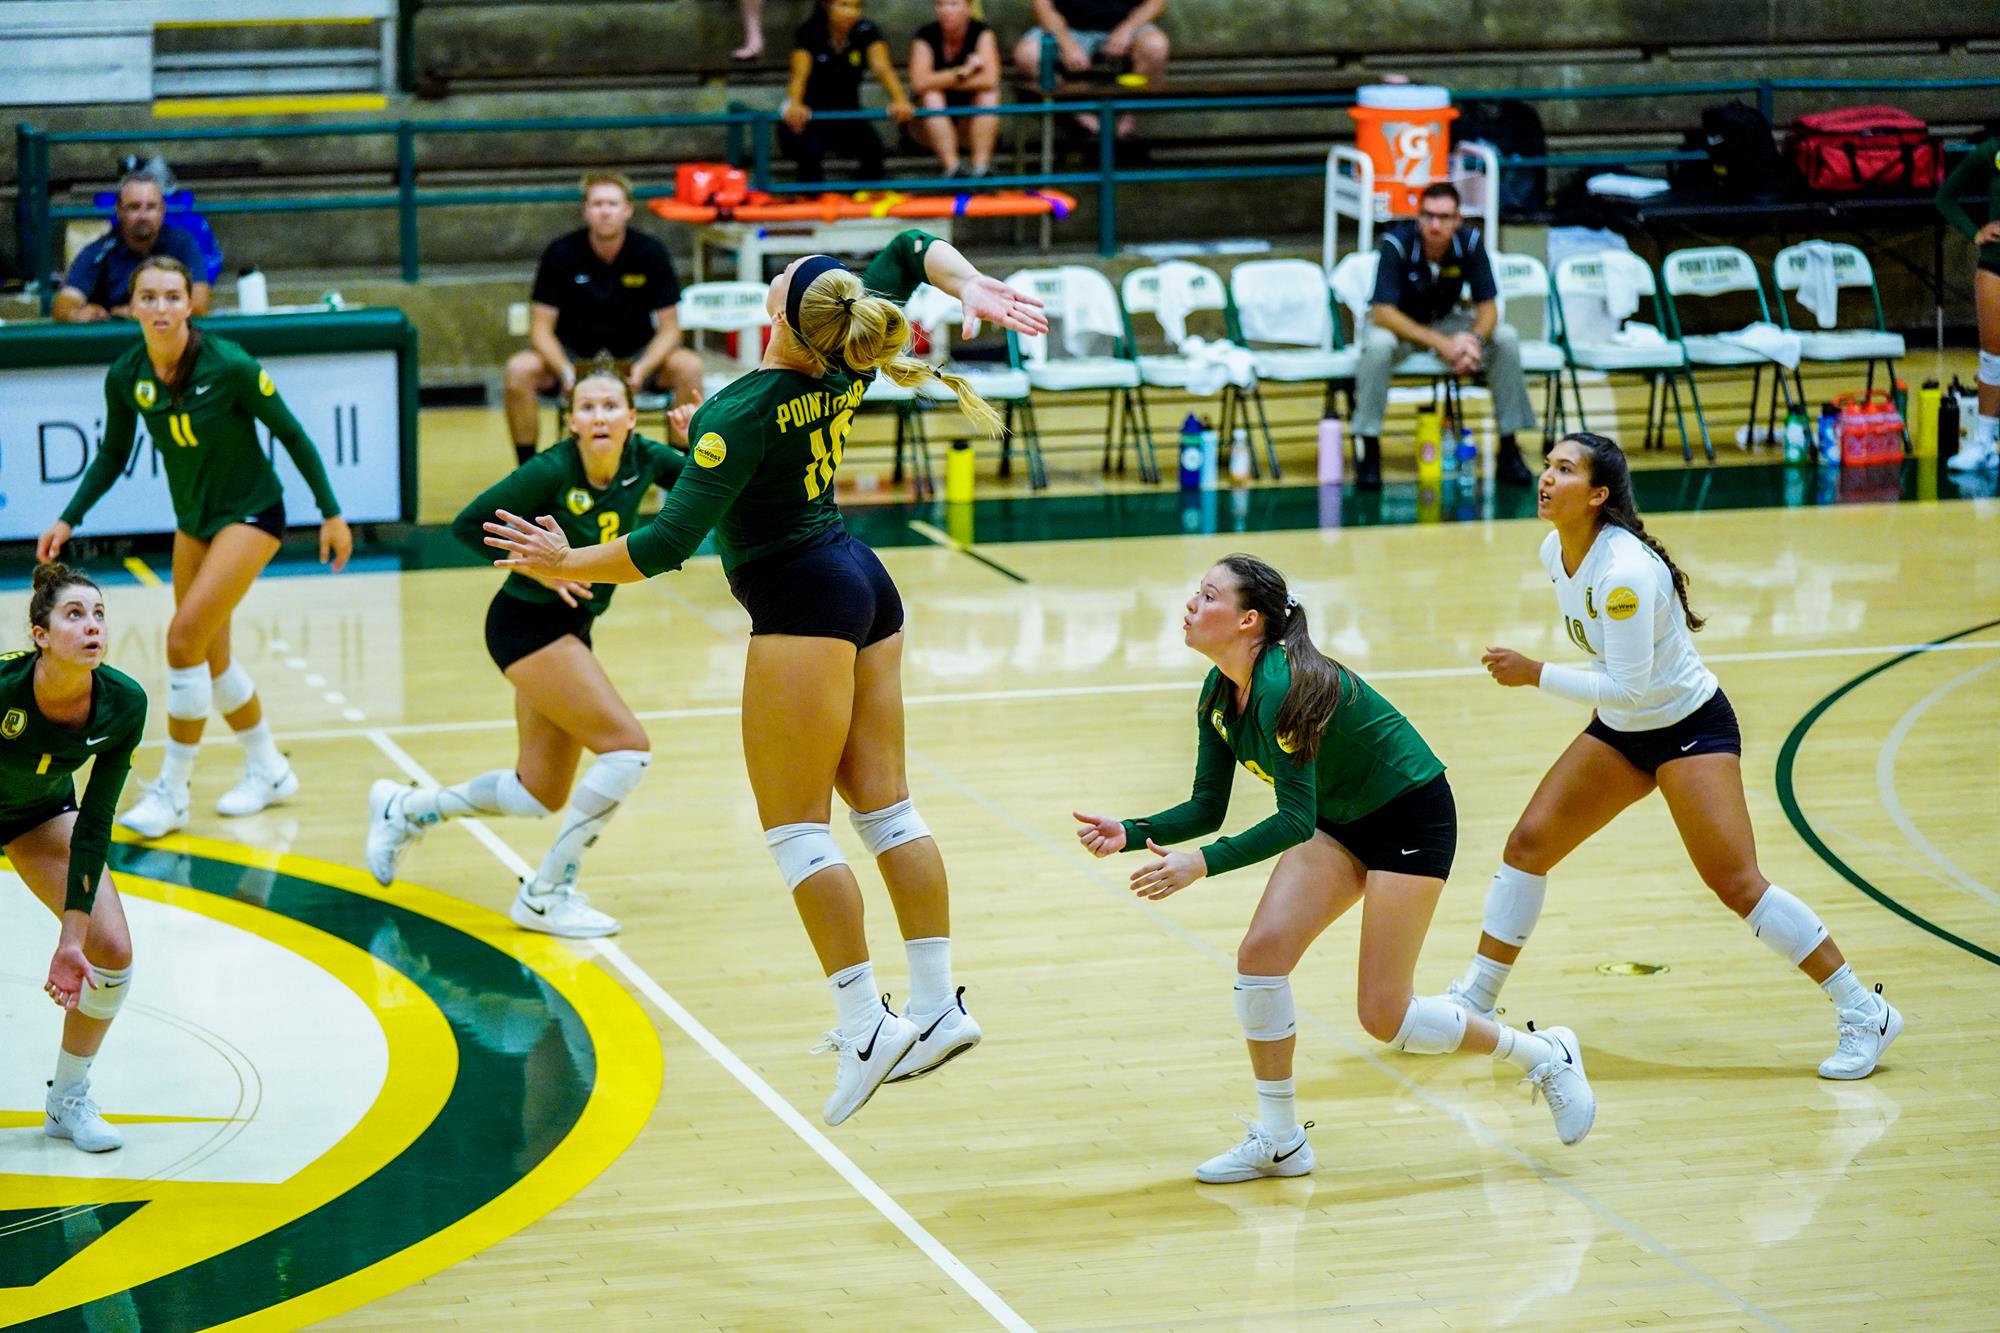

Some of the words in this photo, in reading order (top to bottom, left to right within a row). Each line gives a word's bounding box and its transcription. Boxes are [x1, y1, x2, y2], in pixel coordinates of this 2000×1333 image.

[168, 412, 198, 447] 11
[597, 511, 620, 545] 2
[36, 753, 52, 775] 1
